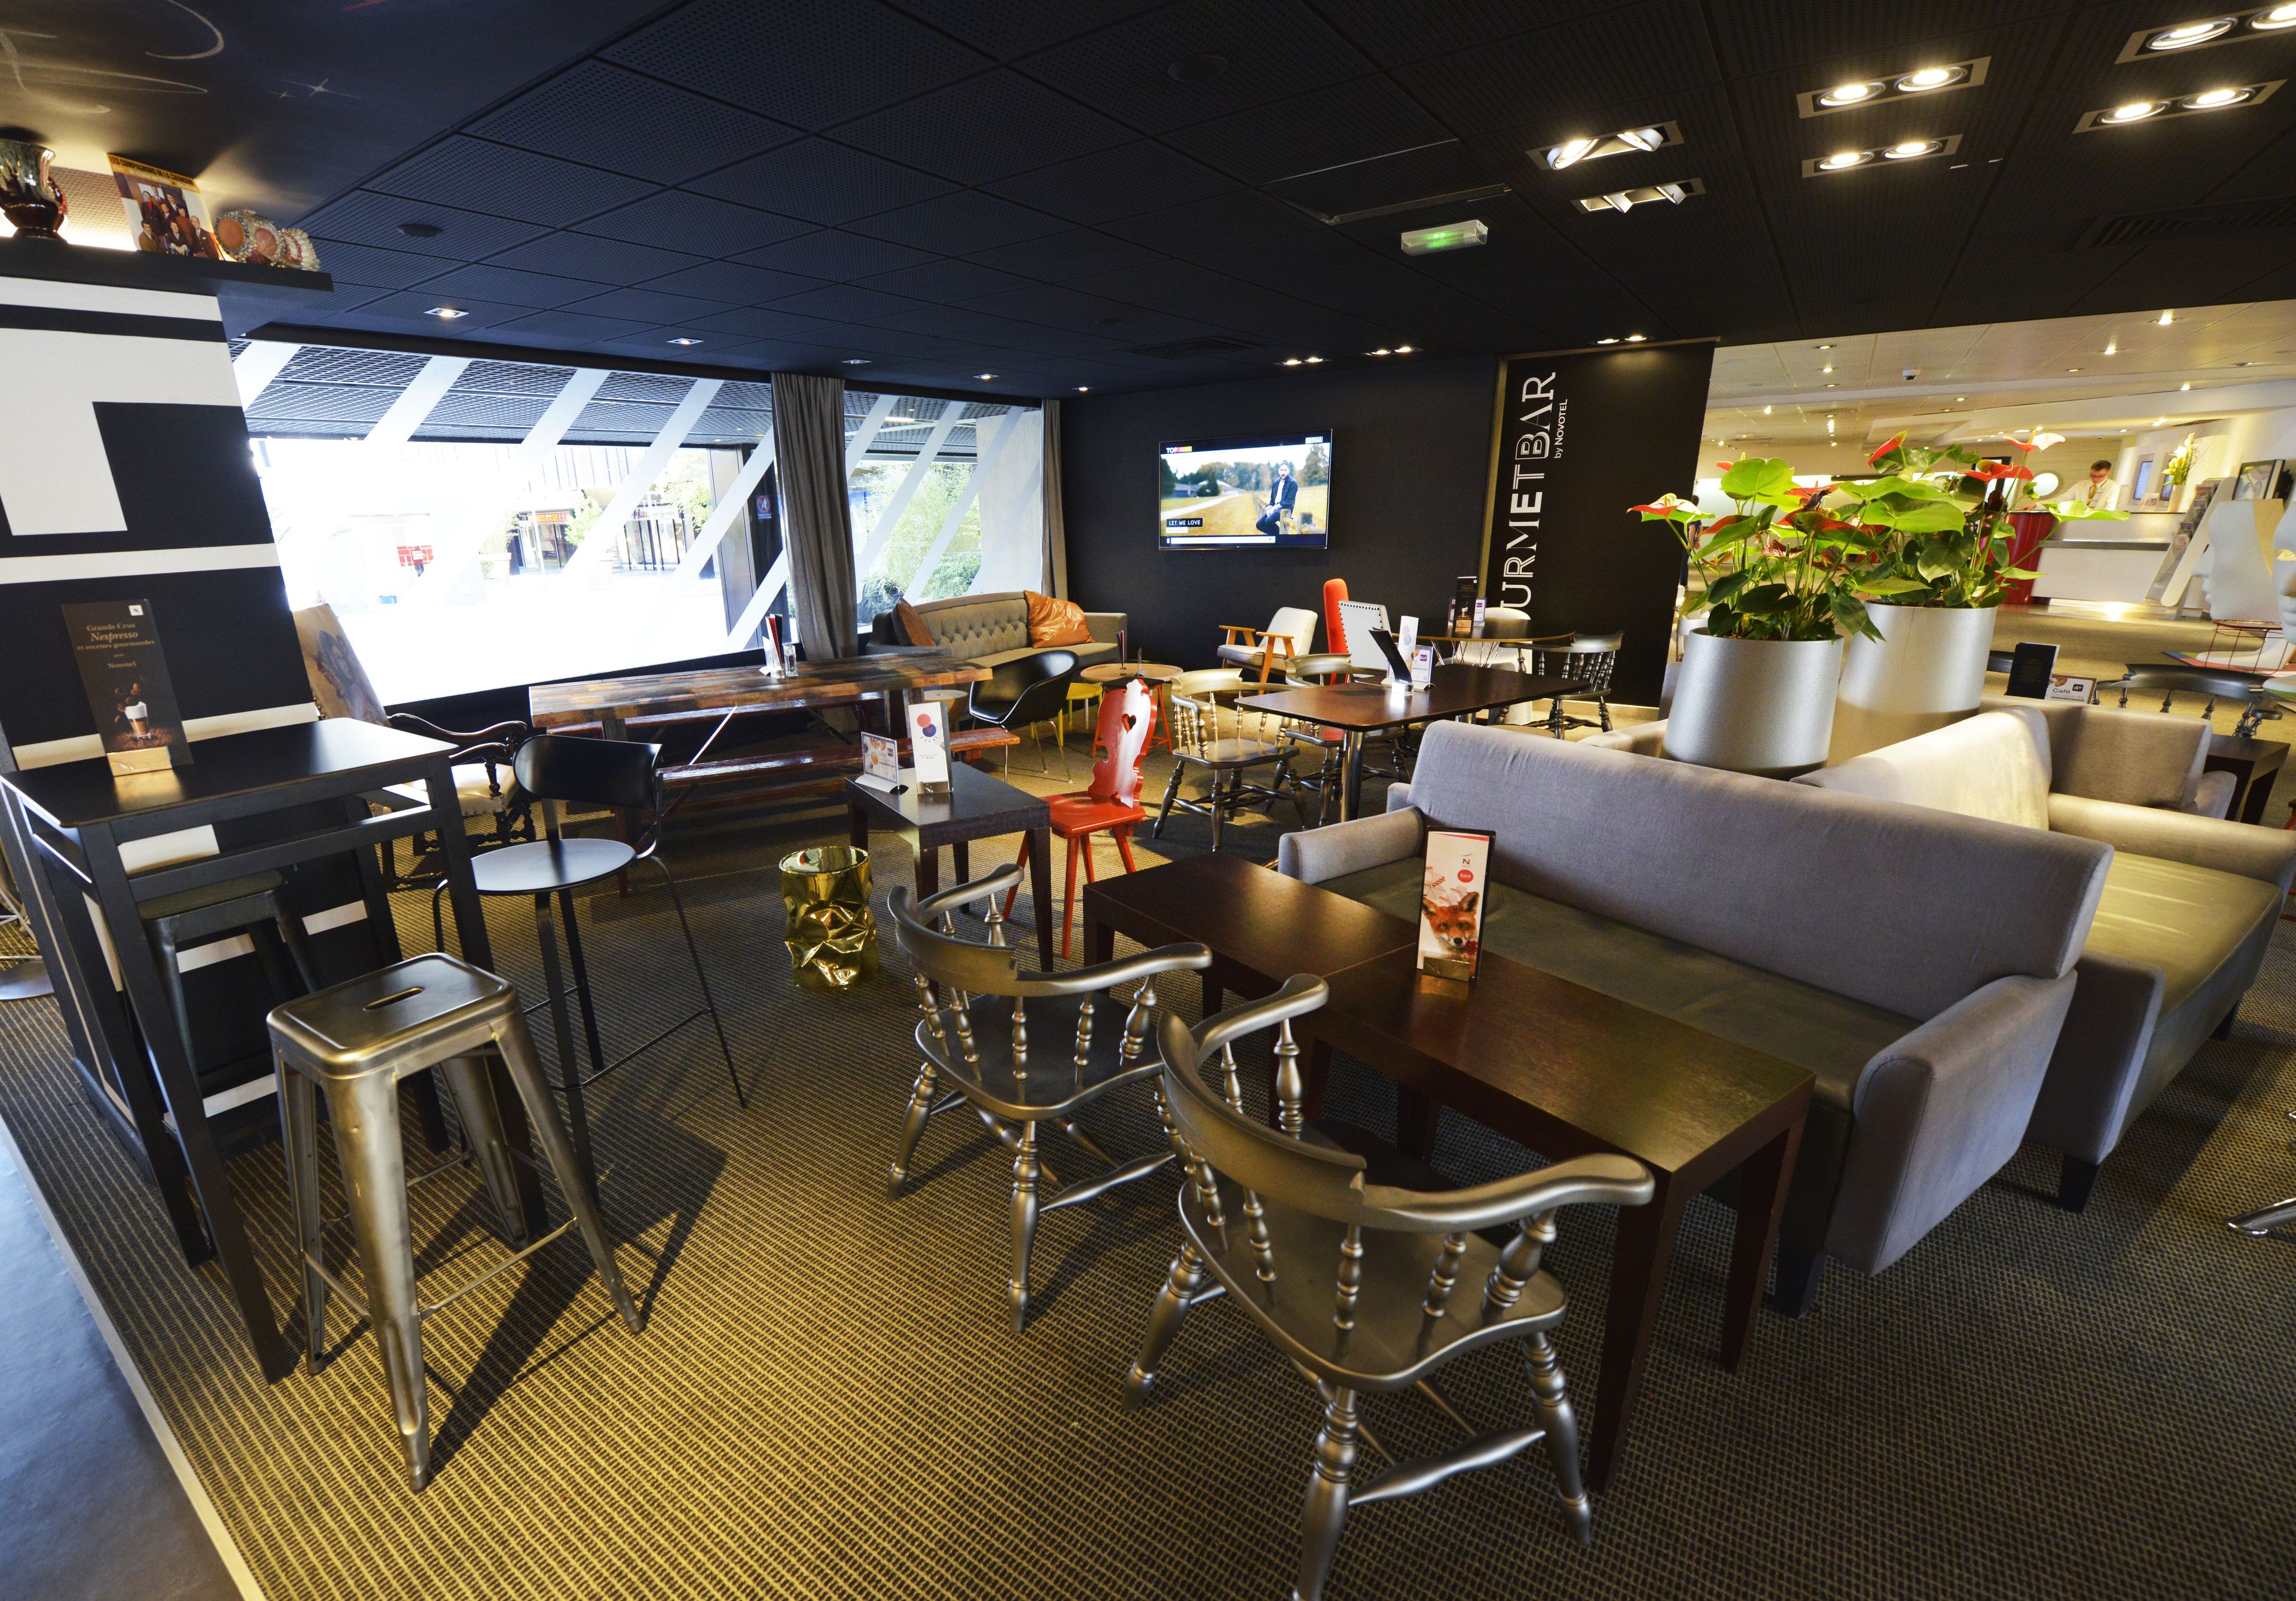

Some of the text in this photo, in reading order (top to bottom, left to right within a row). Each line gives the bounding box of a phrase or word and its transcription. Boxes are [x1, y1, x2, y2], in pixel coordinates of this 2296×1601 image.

[1553, 399, 1568, 459] by NOVOTEL
[90, 632, 139, 643] Nespresso
[114, 640, 155, 649] gourmandes
[108, 661, 137, 669] Novotel
